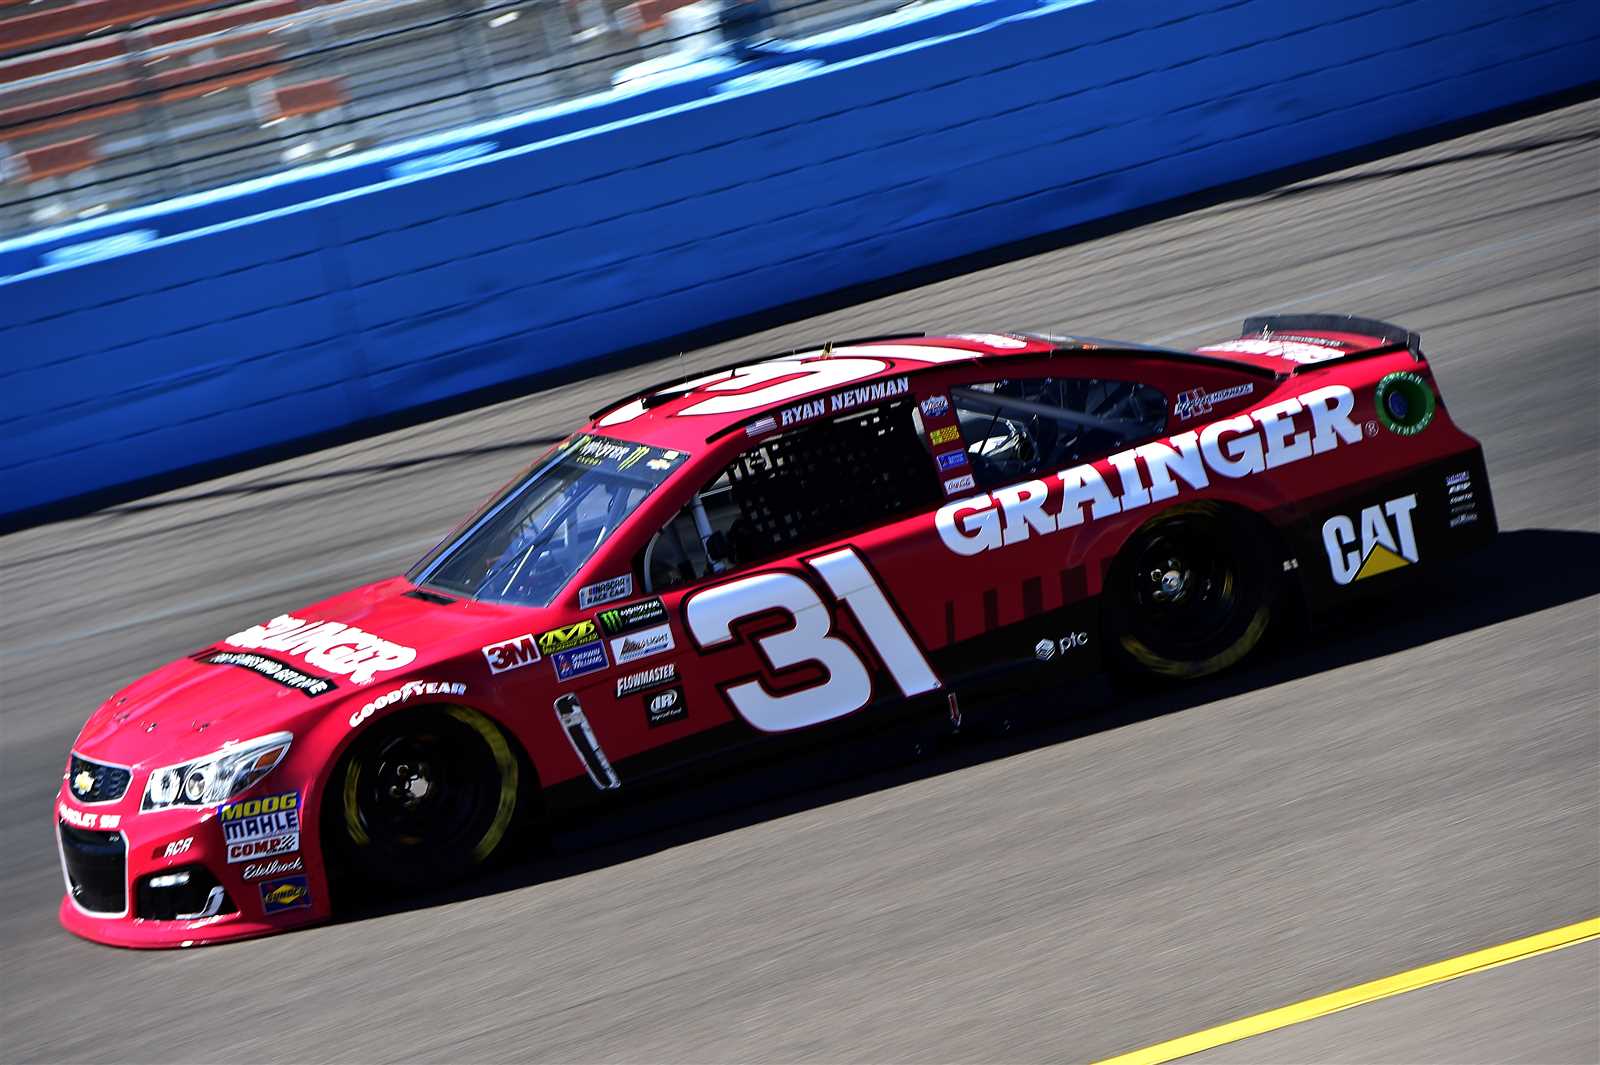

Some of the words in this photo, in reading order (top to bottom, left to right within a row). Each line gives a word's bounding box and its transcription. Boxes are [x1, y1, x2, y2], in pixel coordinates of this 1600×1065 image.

[781, 398, 825, 427] RYAN
[831, 376, 909, 412] NEWMAN
[935, 384, 1364, 557] GRAINGER
[1322, 493, 1420, 586] CAT
[488, 639, 539, 669] 3M
[687, 548, 942, 732] 31
[1059, 631, 1088, 655] ptc
[617, 664, 675, 698] FLOWMASTER
[349, 679, 467, 728] GOODYEAR
[221, 791, 298, 821] MOOG
[226, 812, 298, 840] MAHLE
[231, 837, 282, 858] COMP
[243, 857, 304, 880] Edelbrock
